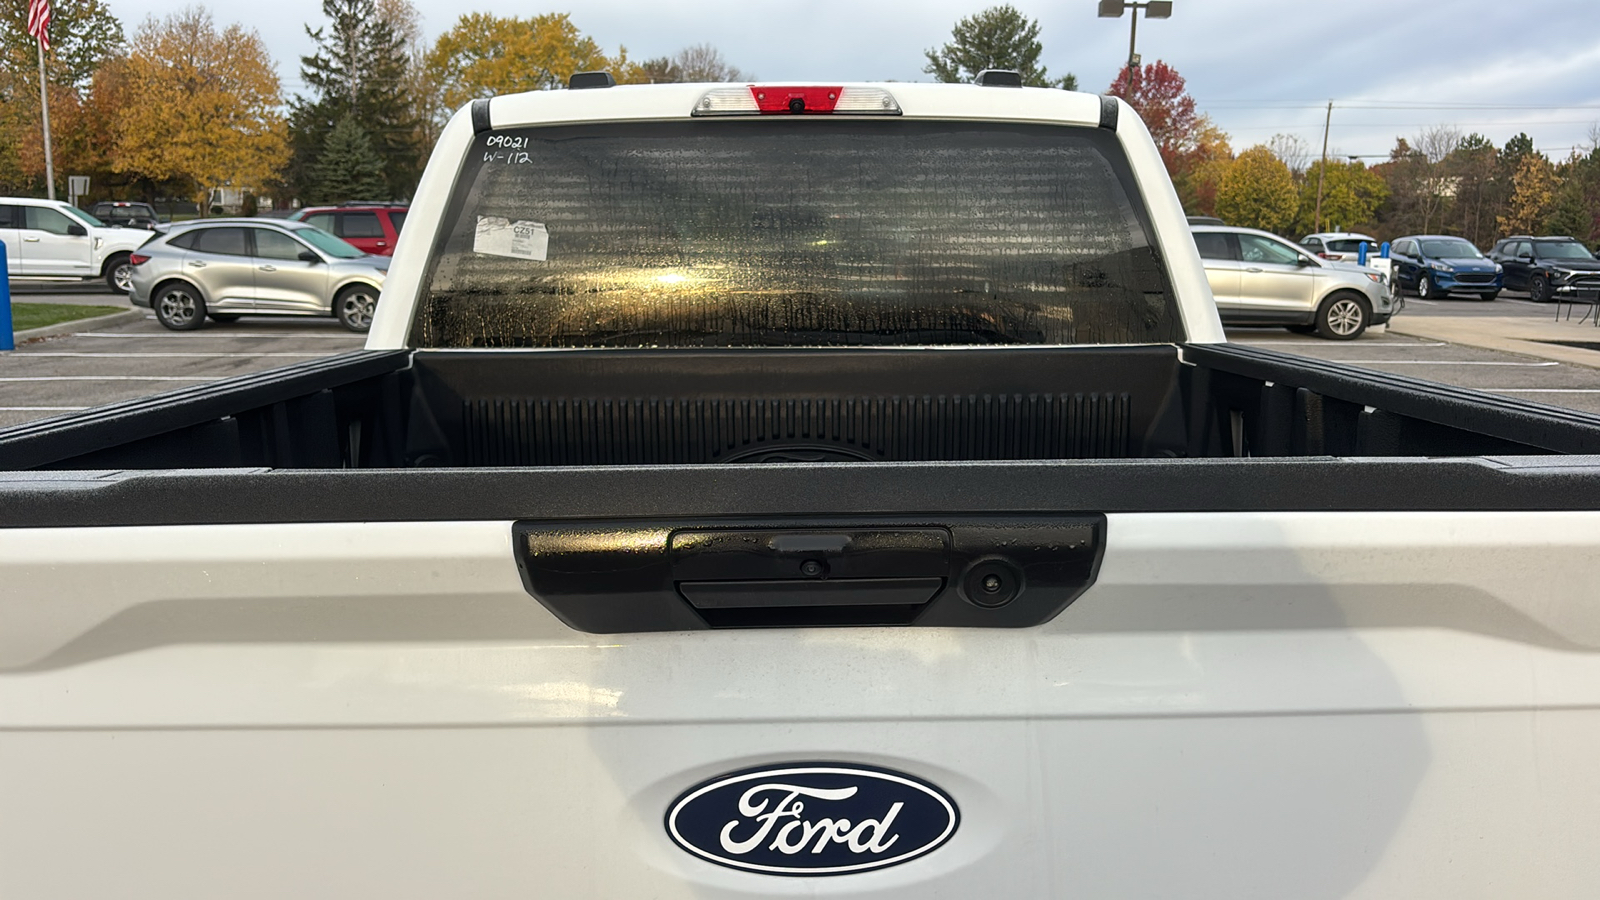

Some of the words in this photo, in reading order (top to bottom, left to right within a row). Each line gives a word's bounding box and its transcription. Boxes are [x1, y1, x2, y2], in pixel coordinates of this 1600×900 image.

[486, 135, 529, 149] 09021
[483, 151, 533, 165] W-112
[513, 225, 535, 236] CZ51
[719, 783, 905, 855] Ford
